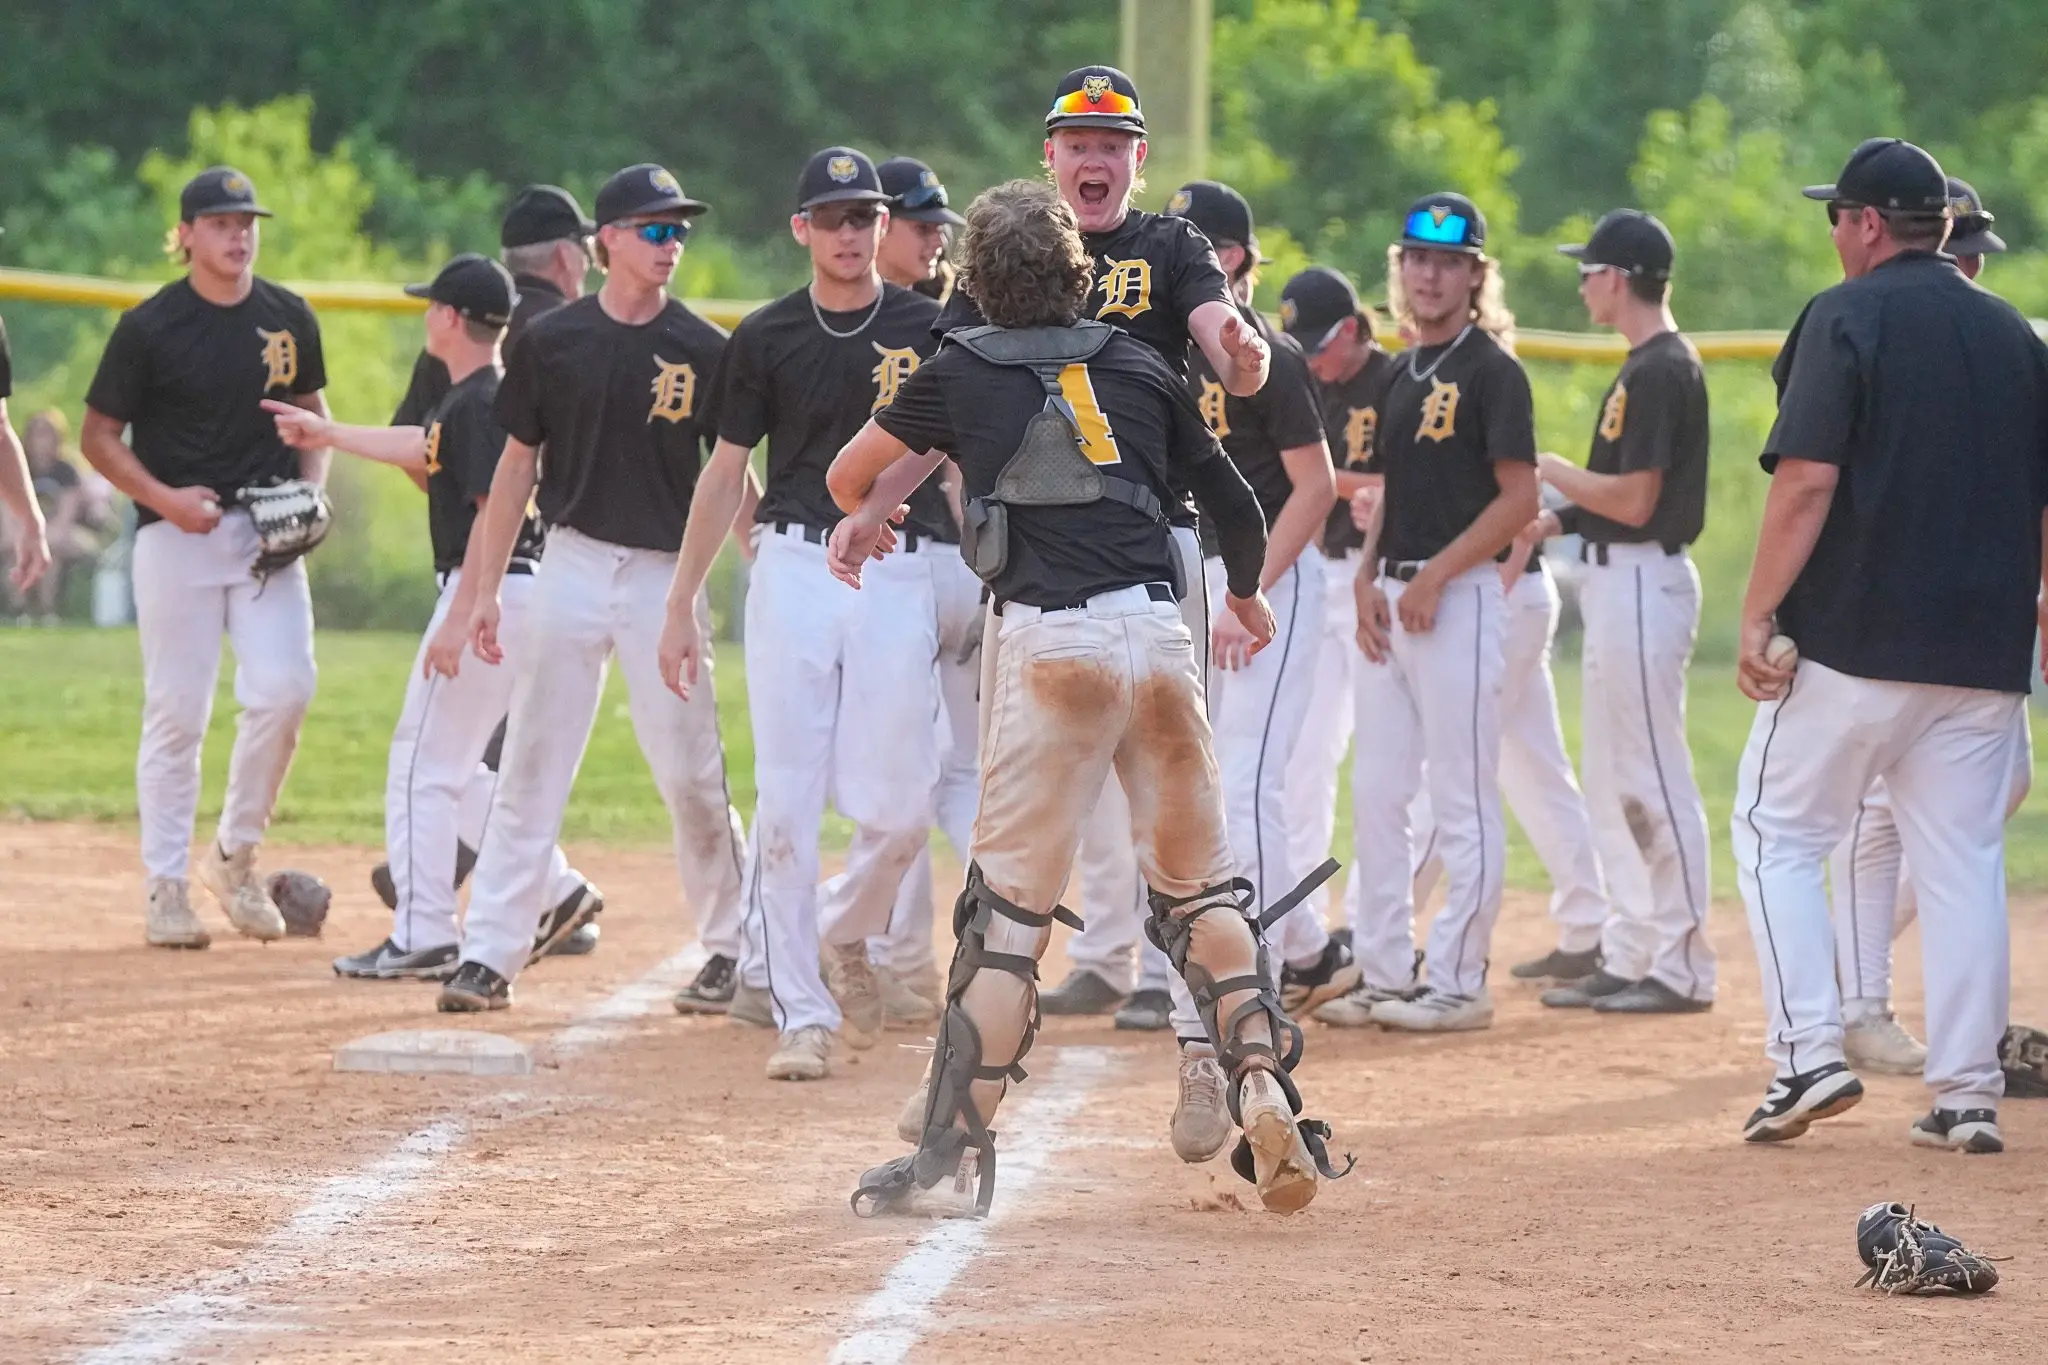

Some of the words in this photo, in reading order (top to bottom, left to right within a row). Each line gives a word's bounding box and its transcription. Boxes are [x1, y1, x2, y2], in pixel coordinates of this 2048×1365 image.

[1095, 255, 1152, 320] D
[256, 326, 298, 393] D
[646, 353, 696, 424] D
[1414, 375, 1460, 443] D
